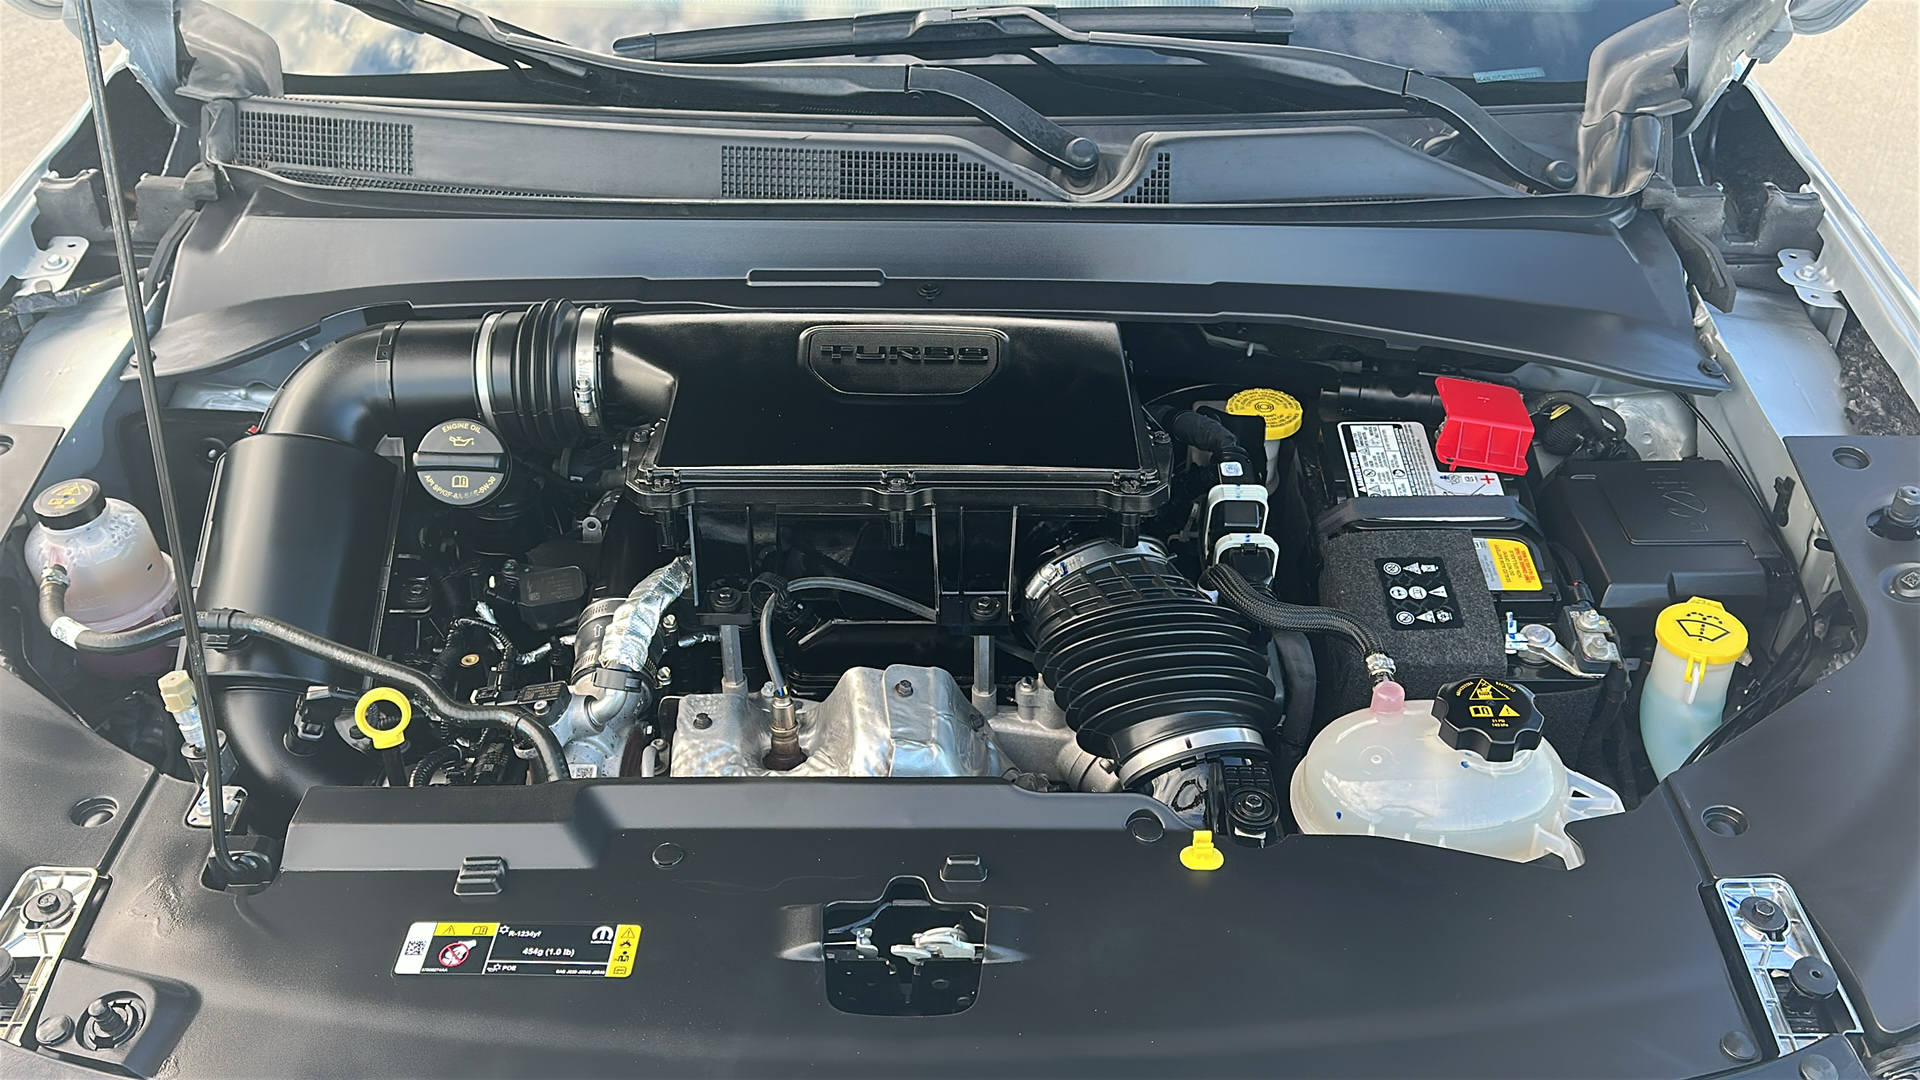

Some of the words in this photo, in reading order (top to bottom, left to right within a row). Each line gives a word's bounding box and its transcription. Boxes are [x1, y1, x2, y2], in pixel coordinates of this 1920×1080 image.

[821, 345, 988, 362] TURBO
[442, 422, 468, 433] ENGINE
[470, 424, 480, 434] OIL
[424, 474, 434, 487] API
[508, 930, 542, 938] R-1234yf
[522, 948, 544, 957] 454g
[545, 948, 561, 957] (1.0
[563, 948, 575, 957] lb)
